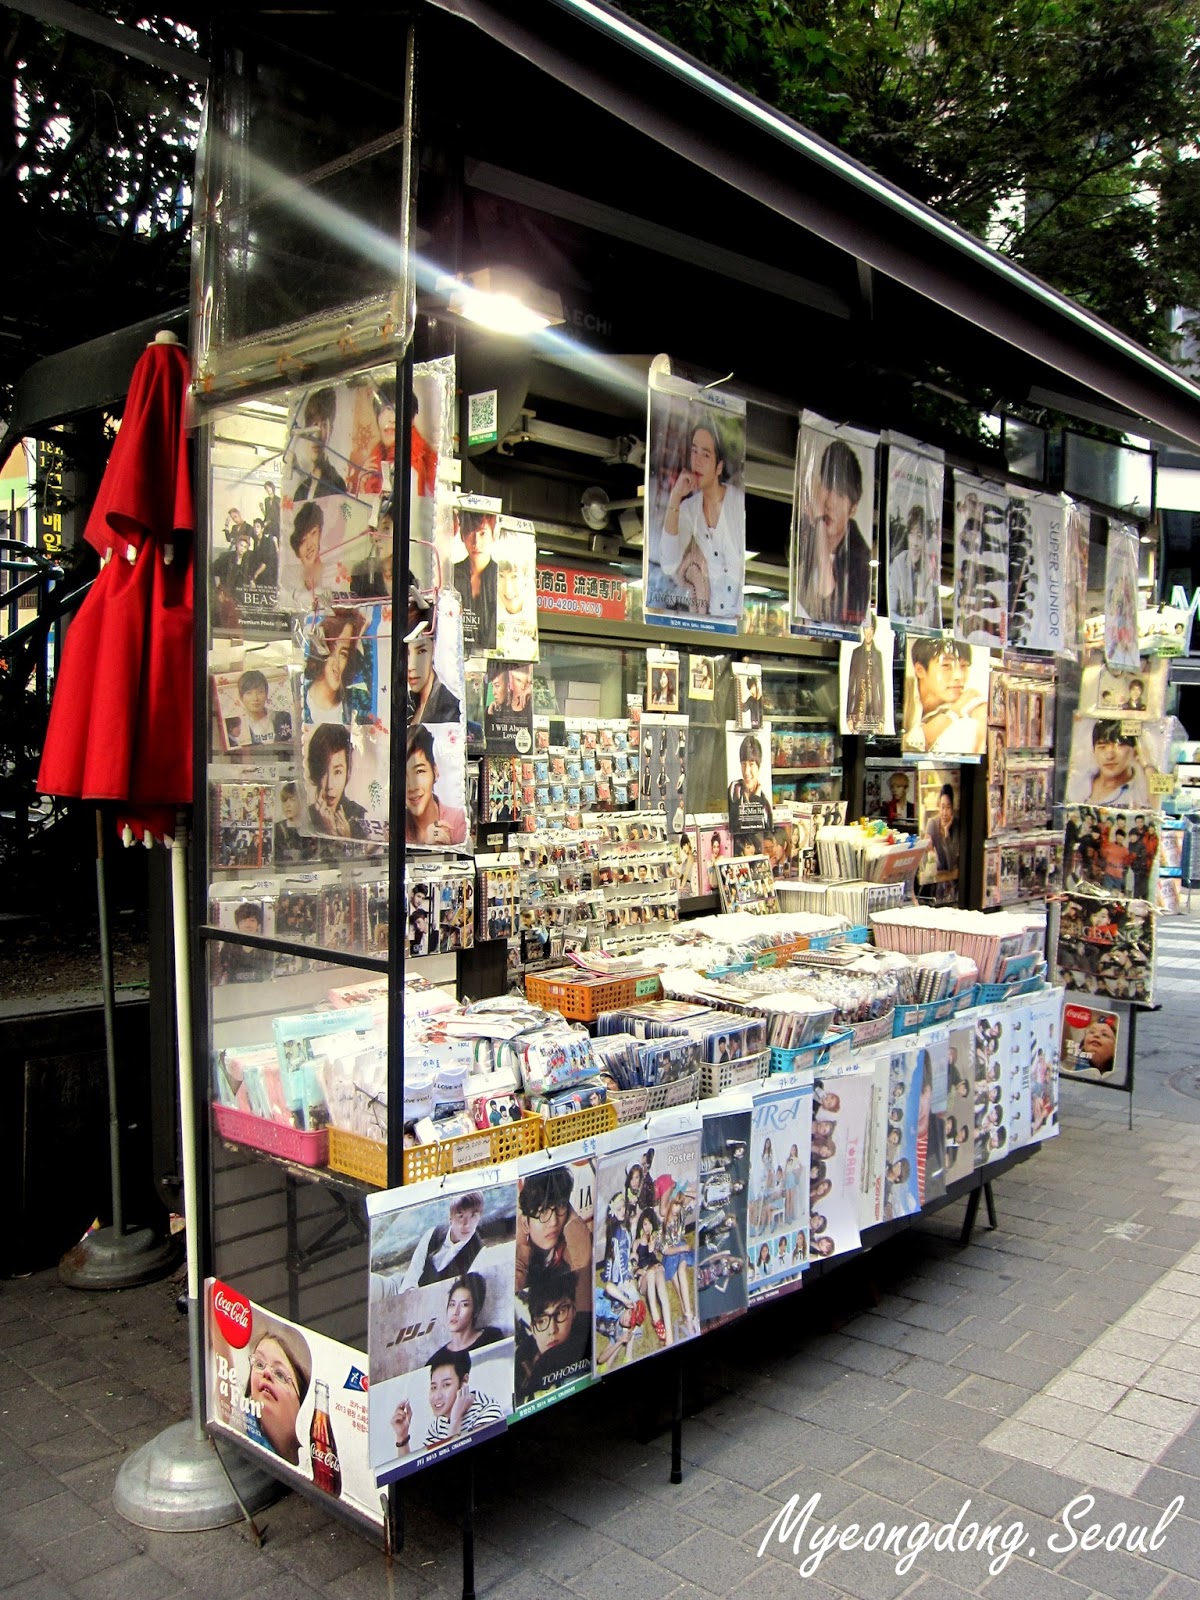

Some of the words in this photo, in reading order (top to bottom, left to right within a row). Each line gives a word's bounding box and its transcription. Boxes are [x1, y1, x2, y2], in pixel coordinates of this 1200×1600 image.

[1049, 521, 1061, 572] SUPER
[244, 592, 277, 605] BEAS
[1049, 576, 1060, 637] JUNIOR
[238, 619, 259, 627] Premium
[463, 615, 480, 625] INKI
[495, 724, 507, 732] Will
[753, 1098, 803, 1131] ARA
[668, 1151, 695, 1166] Poster
[214, 1291, 251, 1328] Coca-Cola
[219, 1379, 229, 1398] a
[451, 1437, 473, 1450] CALENDAR
[311, 1443, 340, 1472] Coca-Cola
